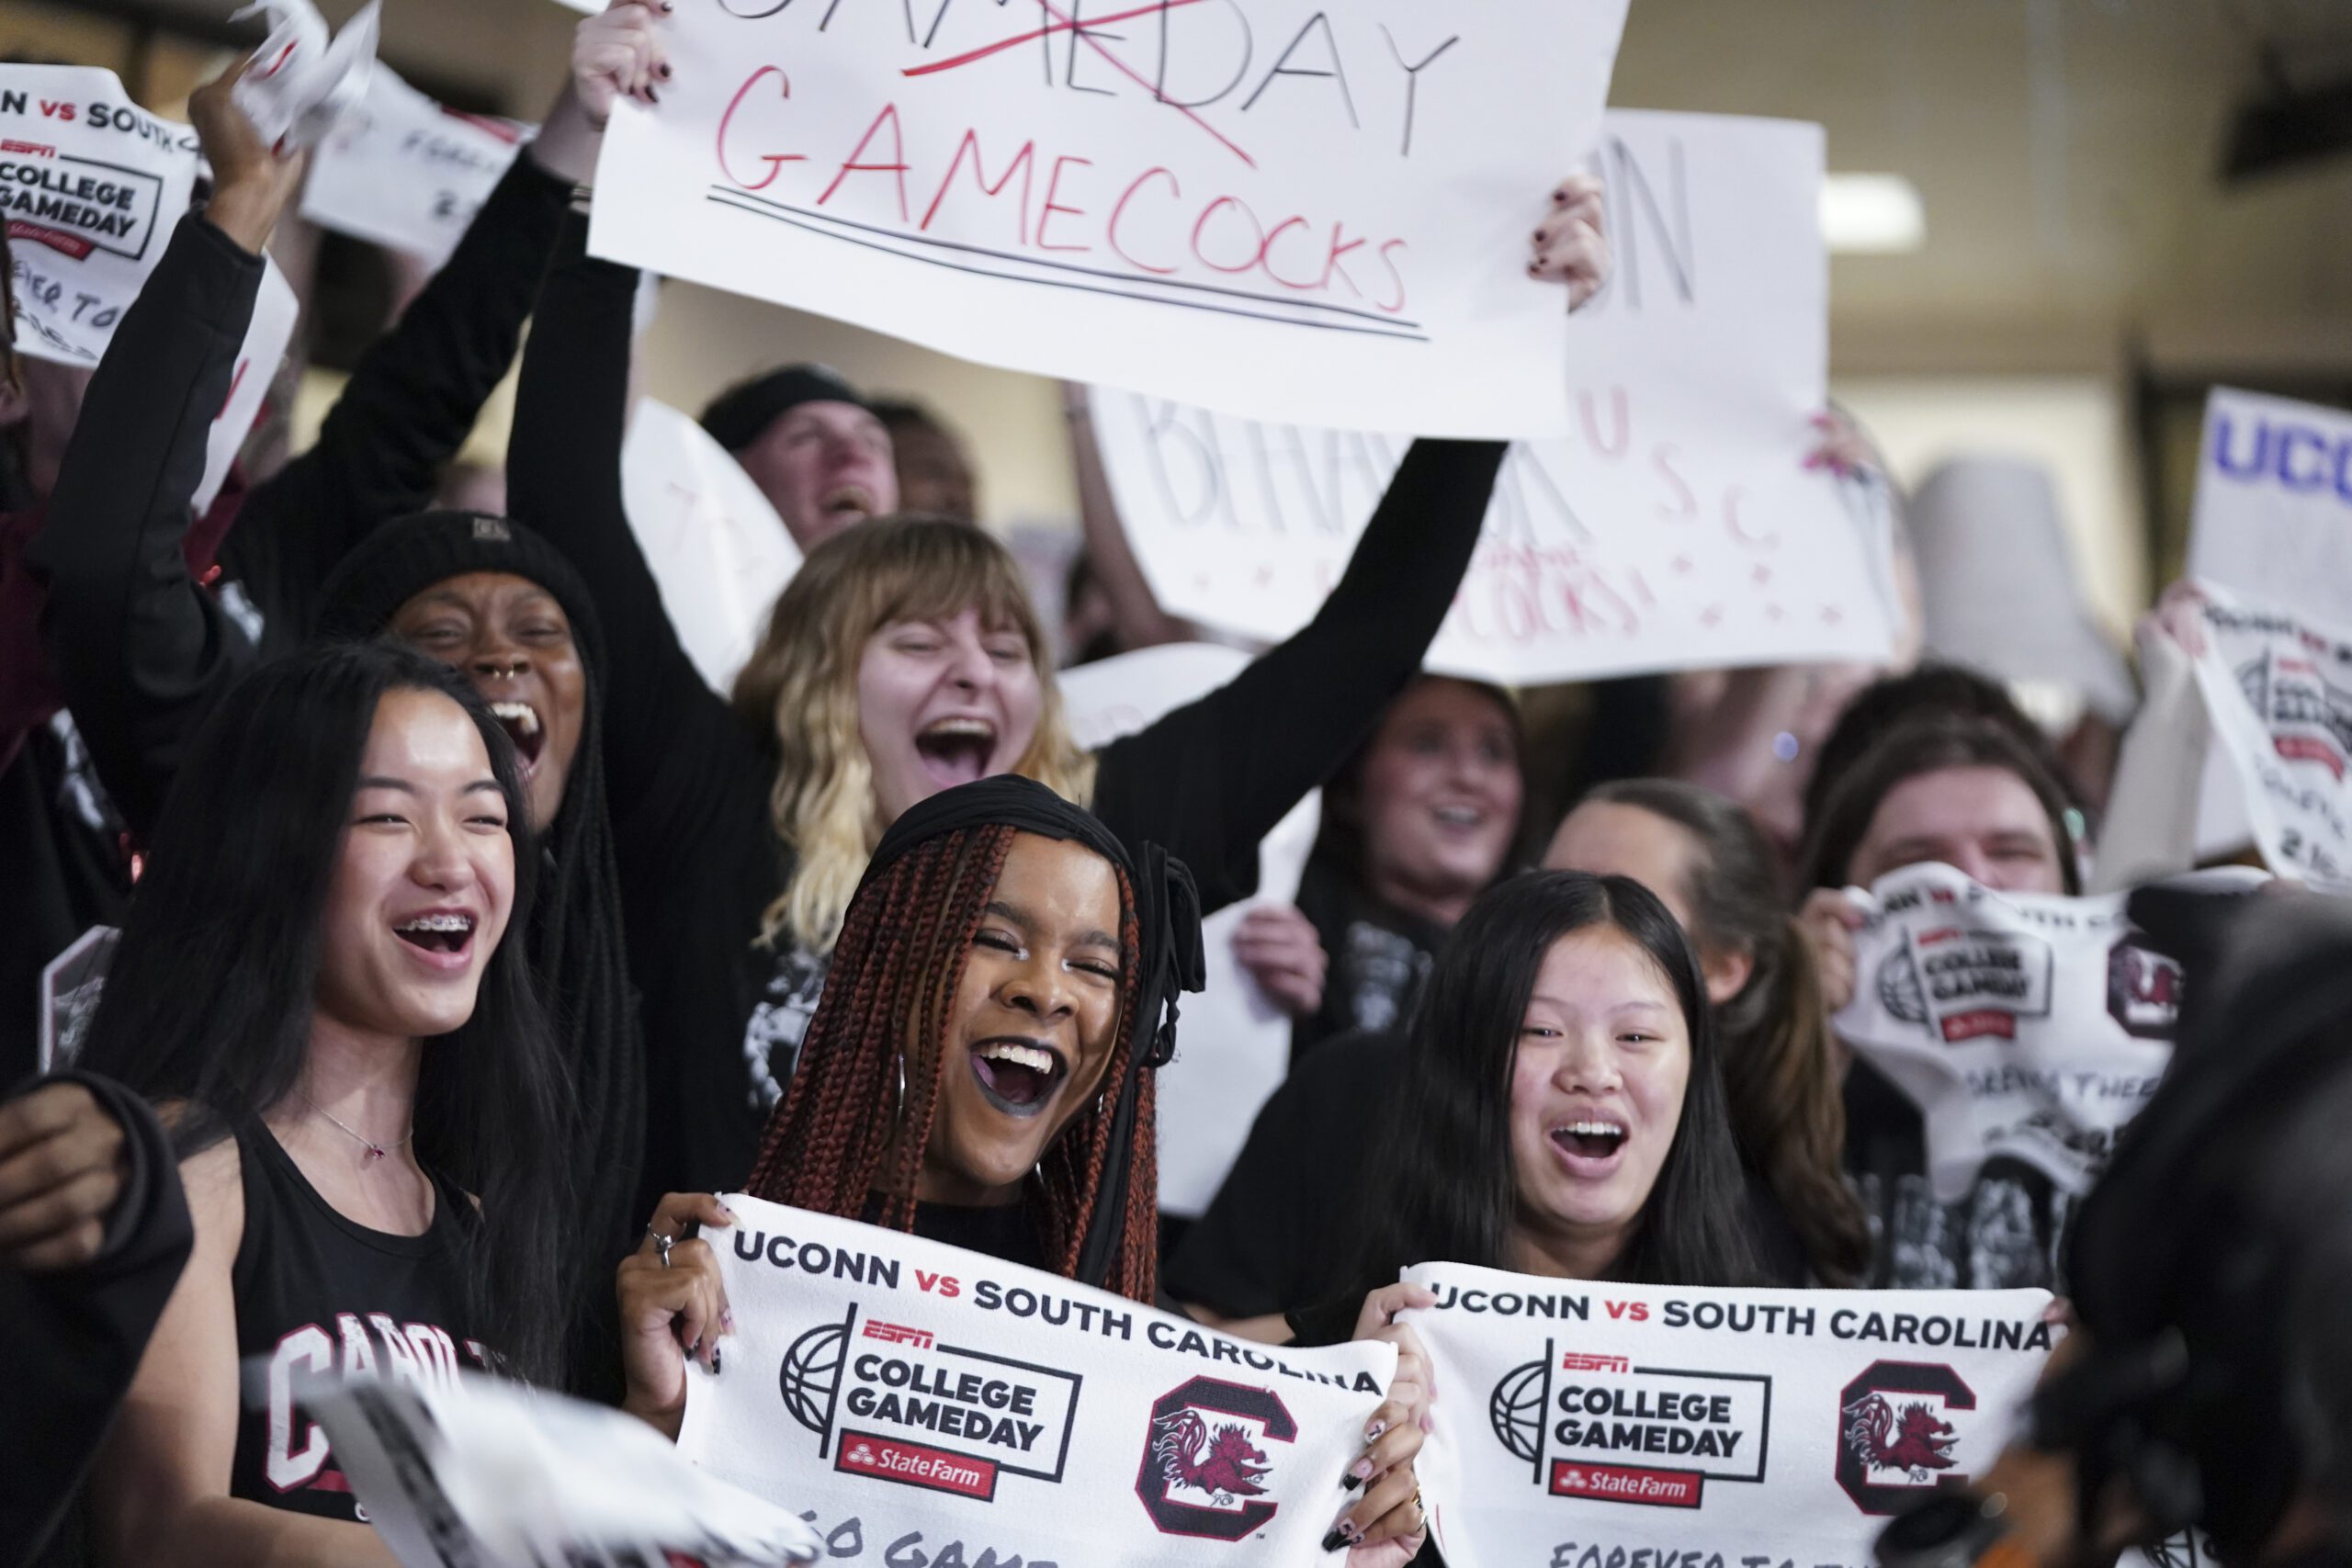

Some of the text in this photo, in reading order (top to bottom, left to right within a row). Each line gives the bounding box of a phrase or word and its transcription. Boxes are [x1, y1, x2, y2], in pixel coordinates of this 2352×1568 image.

[0, 161, 136, 210] COLLEGE
[717, 65, 1408, 312] GAMECOCKS
[734, 1229, 900, 1290] UCONN
[973, 1279, 1132, 1341] SOUTH
[862, 1318, 934, 1349] ESPN
[1430, 1282, 1589, 1321] UCONN
[1662, 1299, 1815, 1337] SOUTH
[1829, 1308, 2052, 1351] CAROLINA
[854, 1353, 1037, 1416] COLLEGE
[1562, 1351, 1630, 1374] ESPN
[846, 1386, 1045, 1452] GAMEDAY
[1557, 1384, 1732, 1424] COLLEGE
[1554, 1418, 1744, 1459] GAMEDAY
